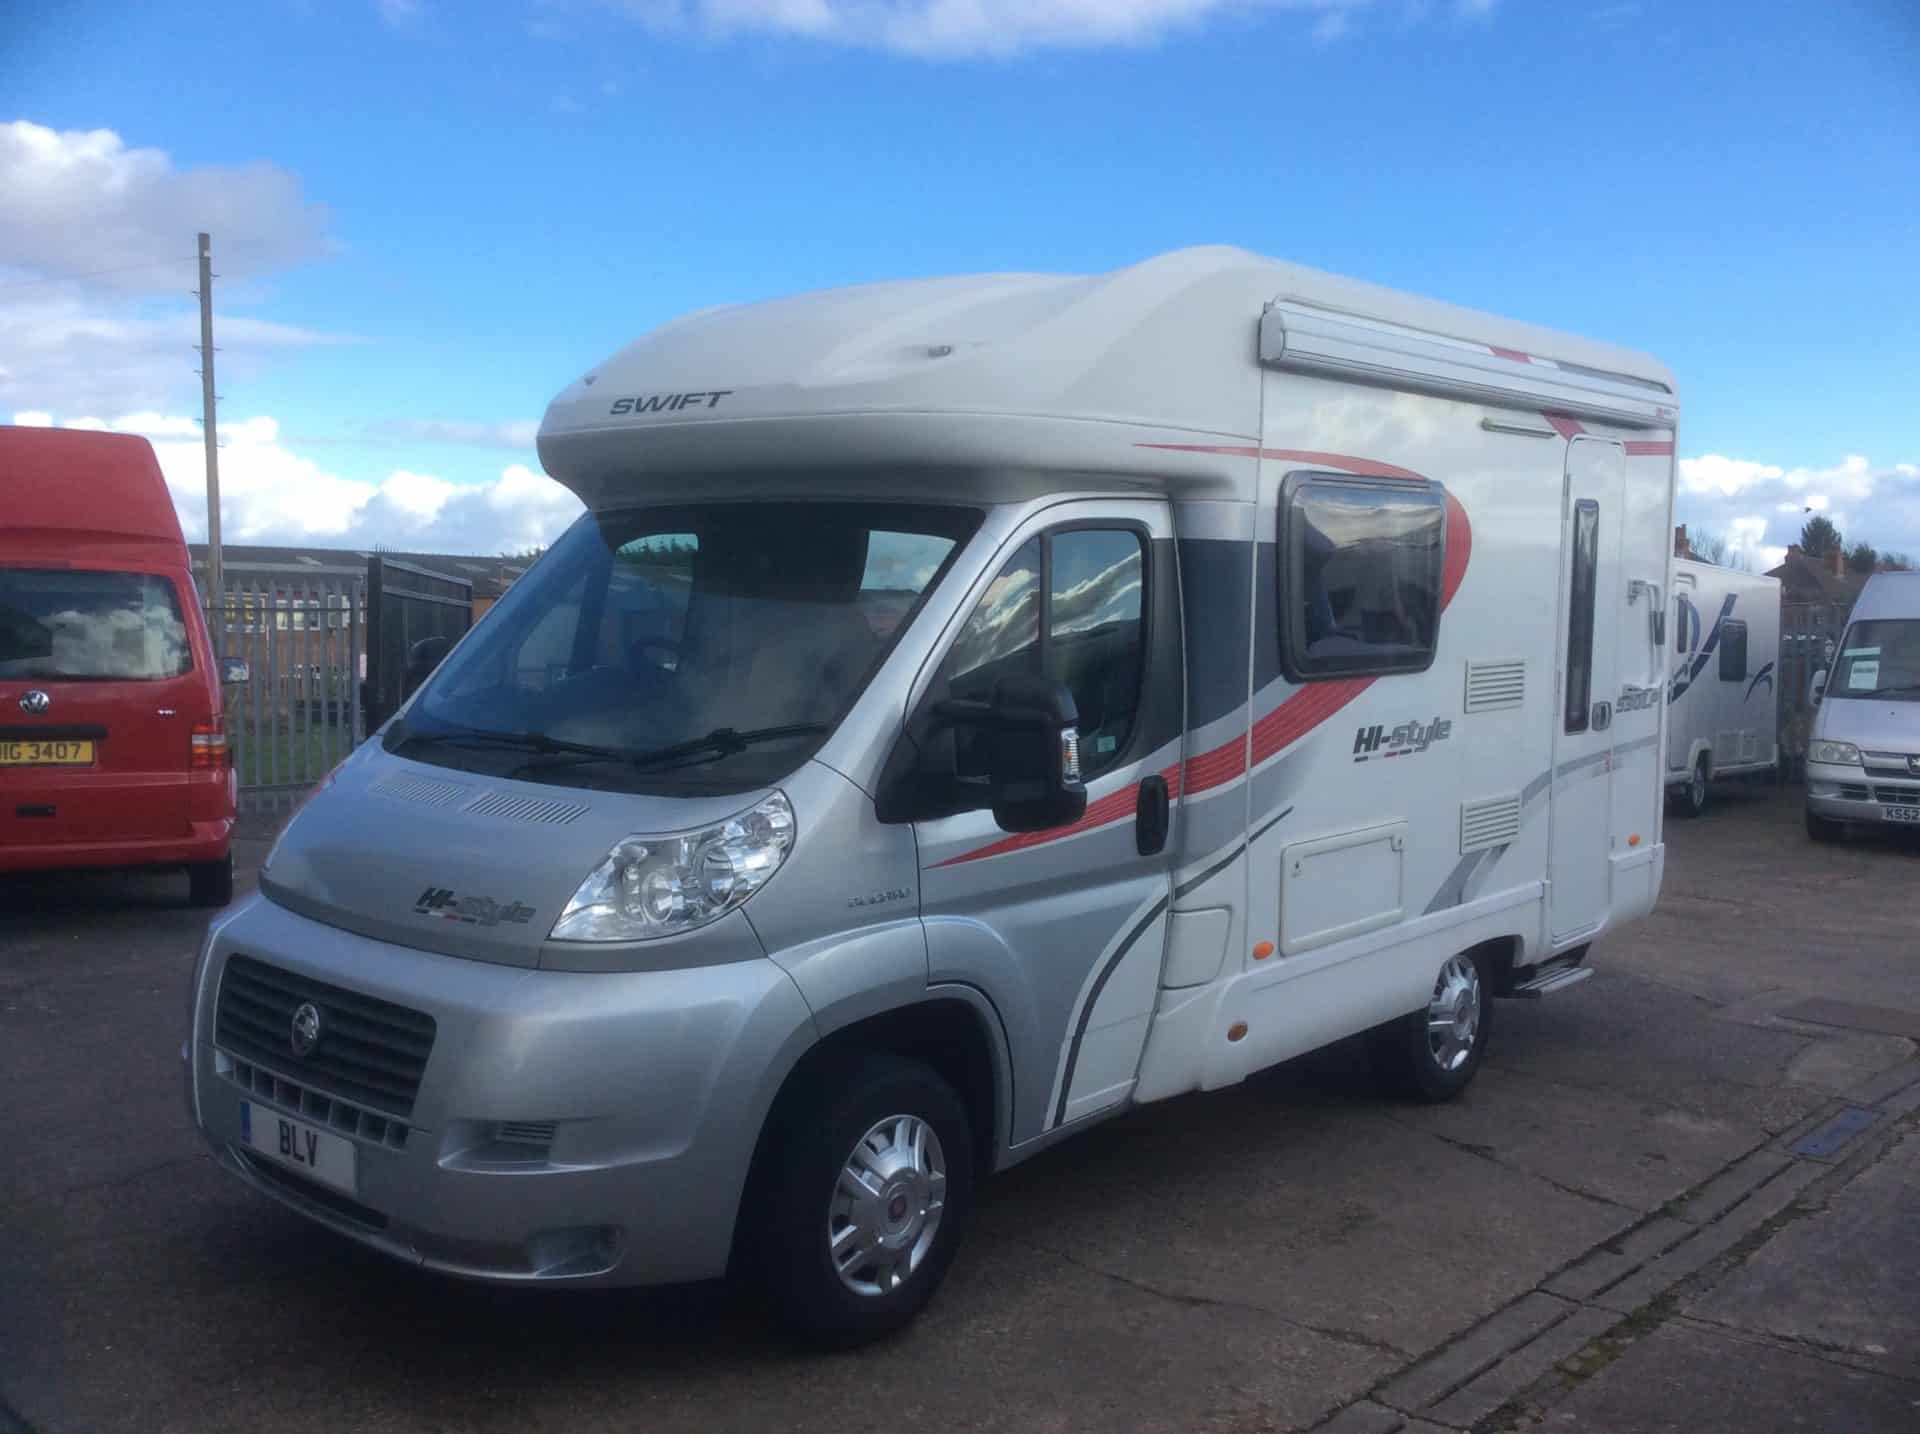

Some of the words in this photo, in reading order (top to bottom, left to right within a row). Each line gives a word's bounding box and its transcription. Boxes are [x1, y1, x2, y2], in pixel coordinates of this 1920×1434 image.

[610, 391, 733, 414] SWIFT
[28, 743, 82, 761] 3407
[278, 1120, 317, 1168] BLV
